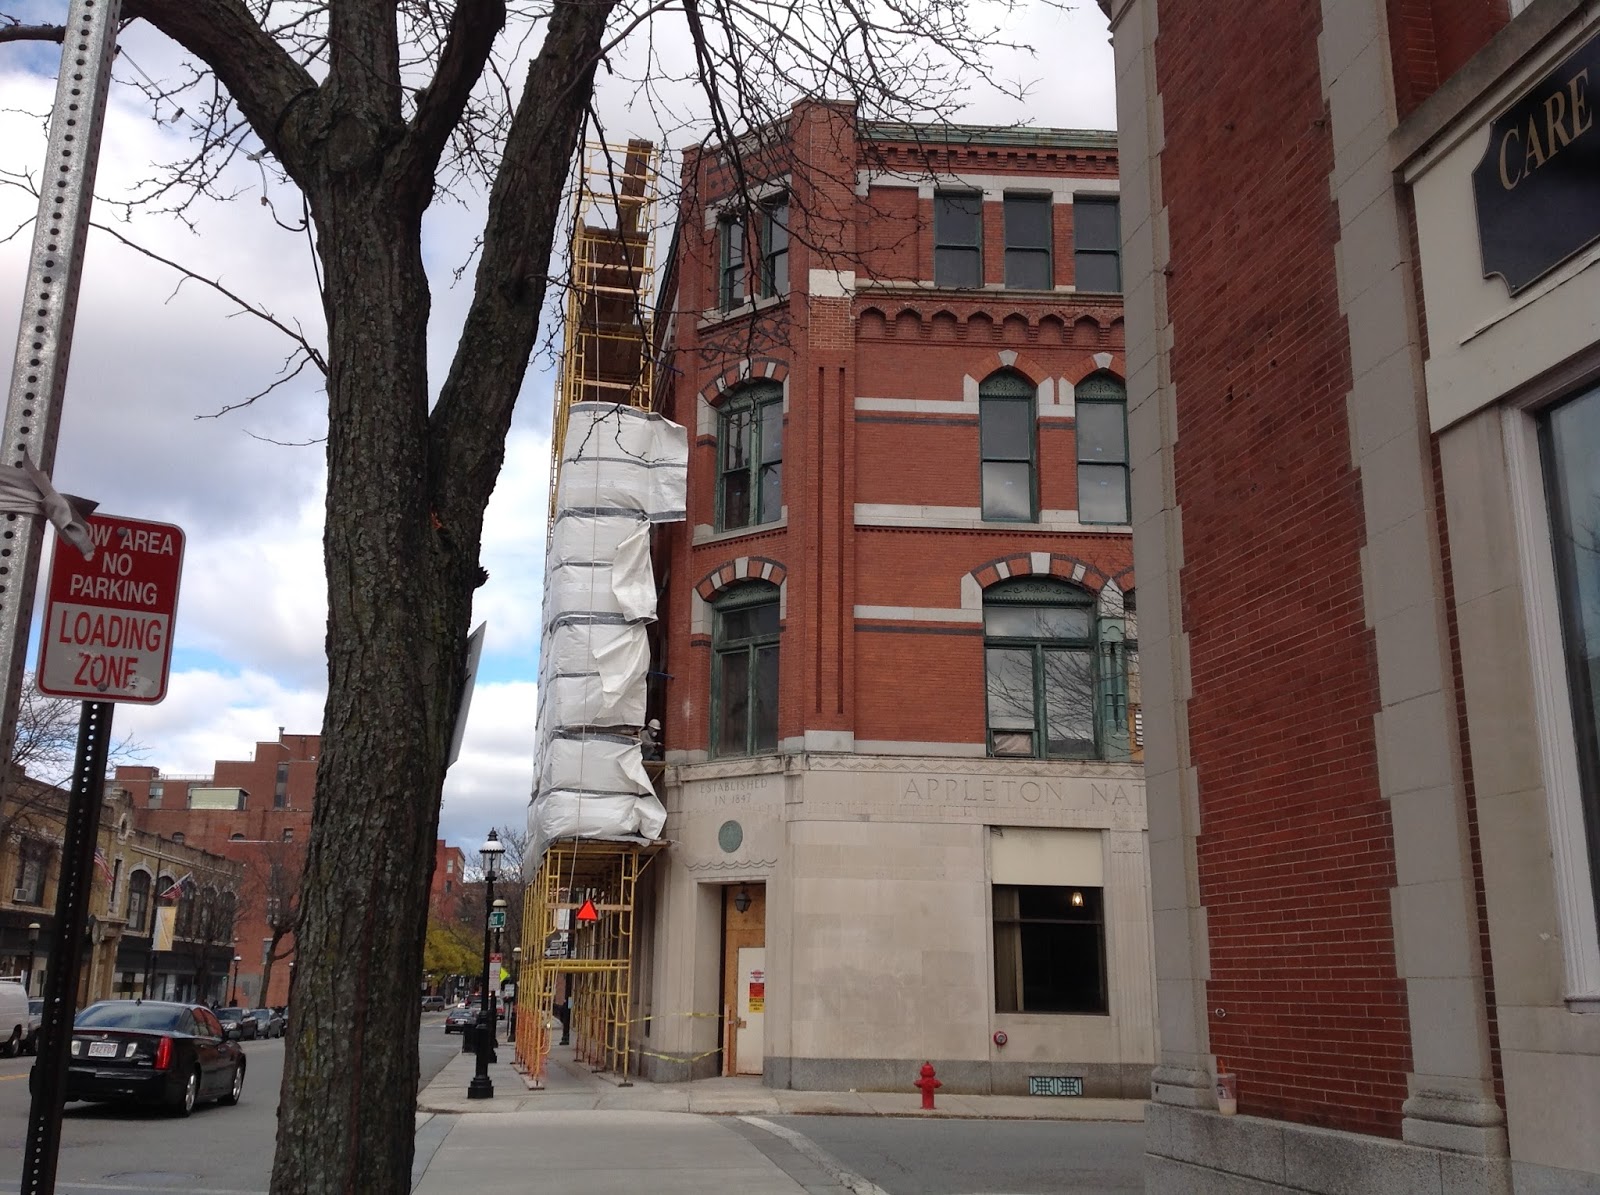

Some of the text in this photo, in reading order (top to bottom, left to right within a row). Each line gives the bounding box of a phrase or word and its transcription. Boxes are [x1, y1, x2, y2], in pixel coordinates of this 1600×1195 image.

[1500, 67, 1593, 191] CARE
[120, 528, 174, 556] AREA
[102, 552, 133, 576] NO
[69, 573, 158, 605] PARKING
[59, 610, 162, 652] LOADING
[74, 652, 139, 689] ZONE
[700, 778, 768, 794] ESTABLISHED
[903, 777, 1063, 803] APPLETON
[714, 795, 726, 806] IN
